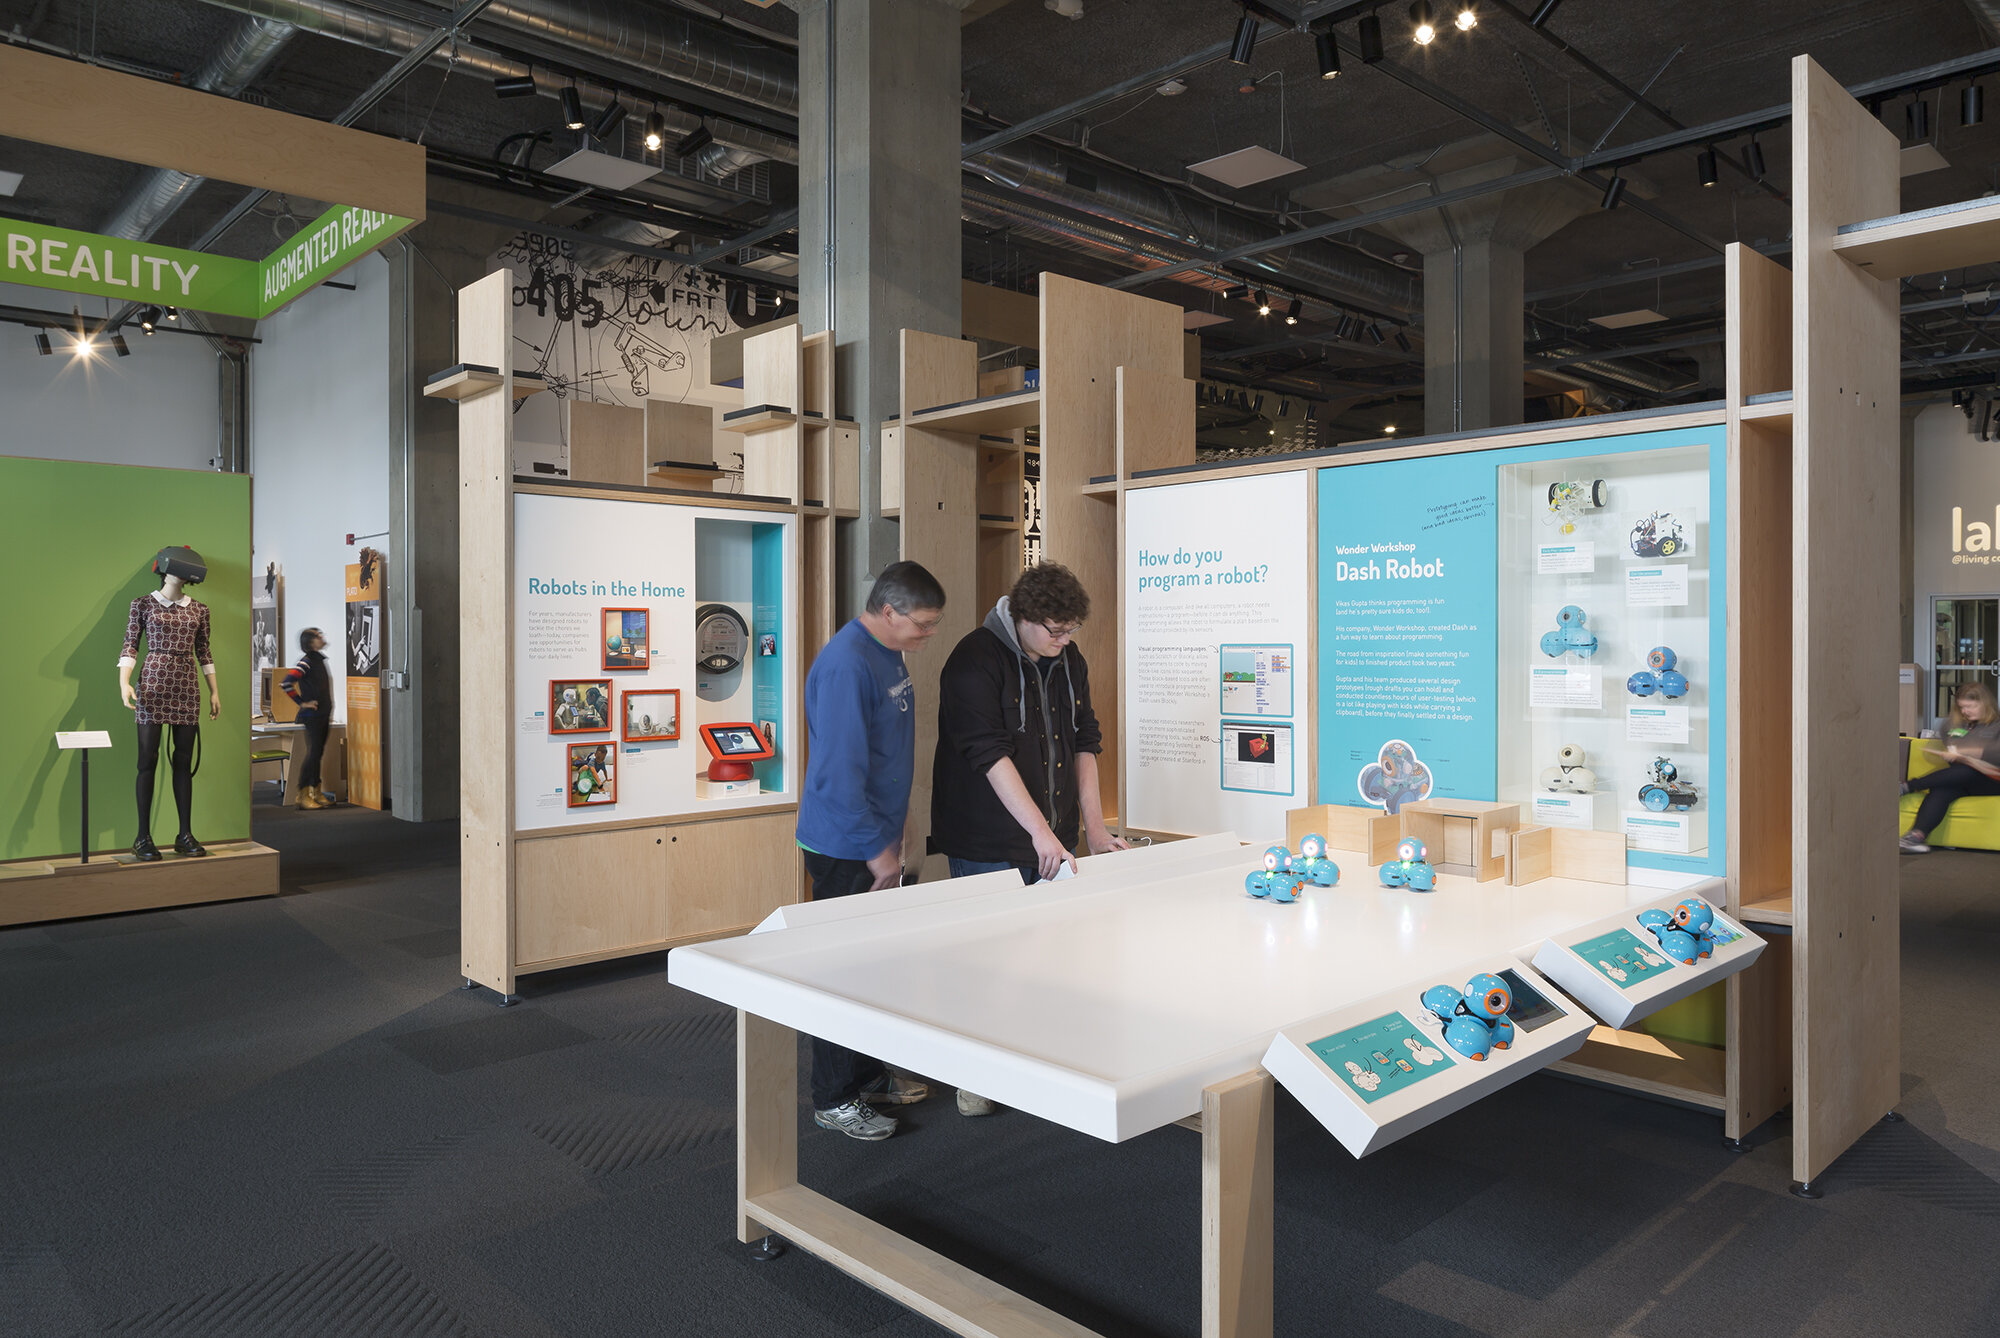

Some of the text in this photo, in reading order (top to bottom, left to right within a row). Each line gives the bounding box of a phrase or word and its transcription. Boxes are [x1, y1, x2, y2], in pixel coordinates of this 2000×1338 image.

[7, 233, 199, 296] REALITY
[264, 220, 338, 303] AUGMENTED
[527, 267, 604, 328] 405
[672, 288, 716, 310] FRT
[1336, 541, 1416, 555] Wonder Workshop
[1139, 547, 1222, 568] How do you
[1952, 554, 1990, 564] @living
[1336, 557, 1444, 582] Dash Robot
[1139, 564, 1269, 593] program a robot?
[528, 578, 686, 598] Robots in the Home
[1386, 599, 1426, 607] programming
[1361, 608, 1378, 616] pretty
[1375, 650, 1405, 658] inspiration
[1426, 650, 1458, 659] something
[1440, 678, 1462, 686] design
[1366, 702, 1386, 710] playing
[1418, 695, 1455, 704] user-testing
